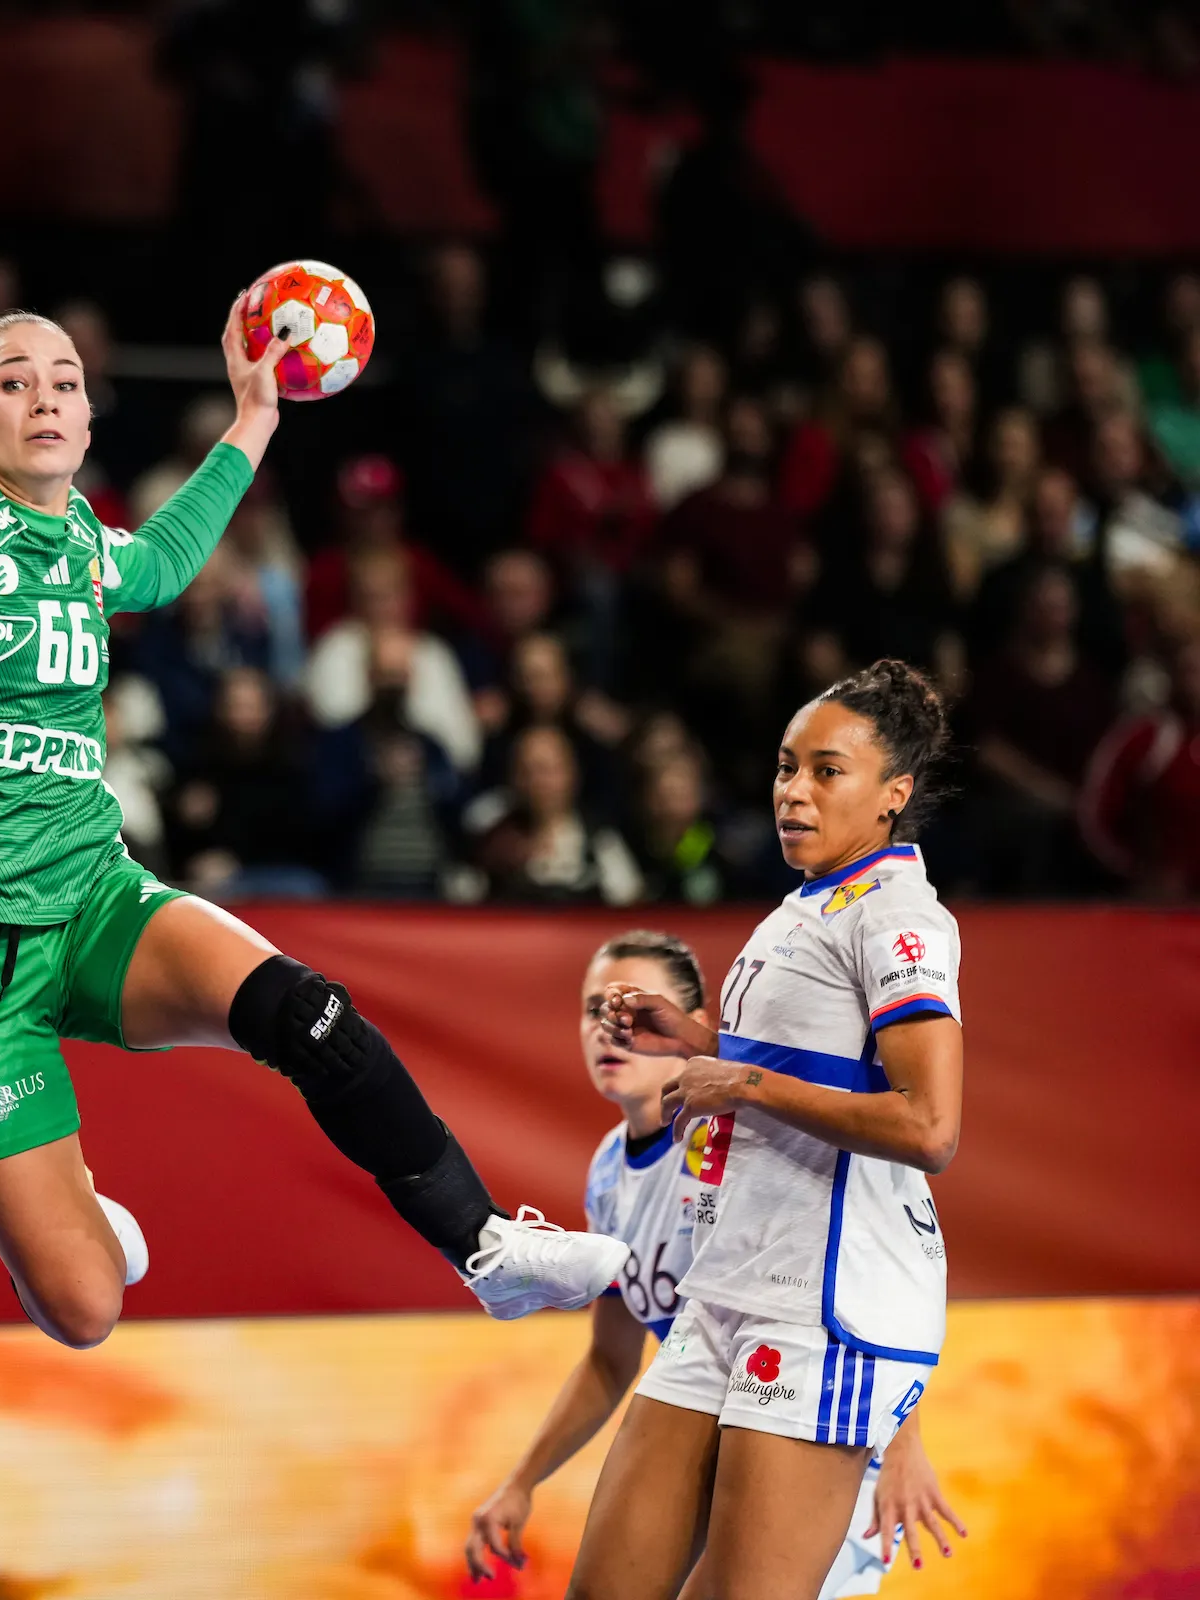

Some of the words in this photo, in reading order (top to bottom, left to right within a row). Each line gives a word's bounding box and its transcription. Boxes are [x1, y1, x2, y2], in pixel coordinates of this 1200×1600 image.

[37, 600, 99, 685] 66
[719, 955, 766, 1033] 27
[880, 970, 906, 988] WOMENS
[931, 969, 946, 982] 2024
[309, 993, 341, 1040] SELECT
[697, 1192, 715, 1208] SE
[623, 1241, 680, 1317] 86
